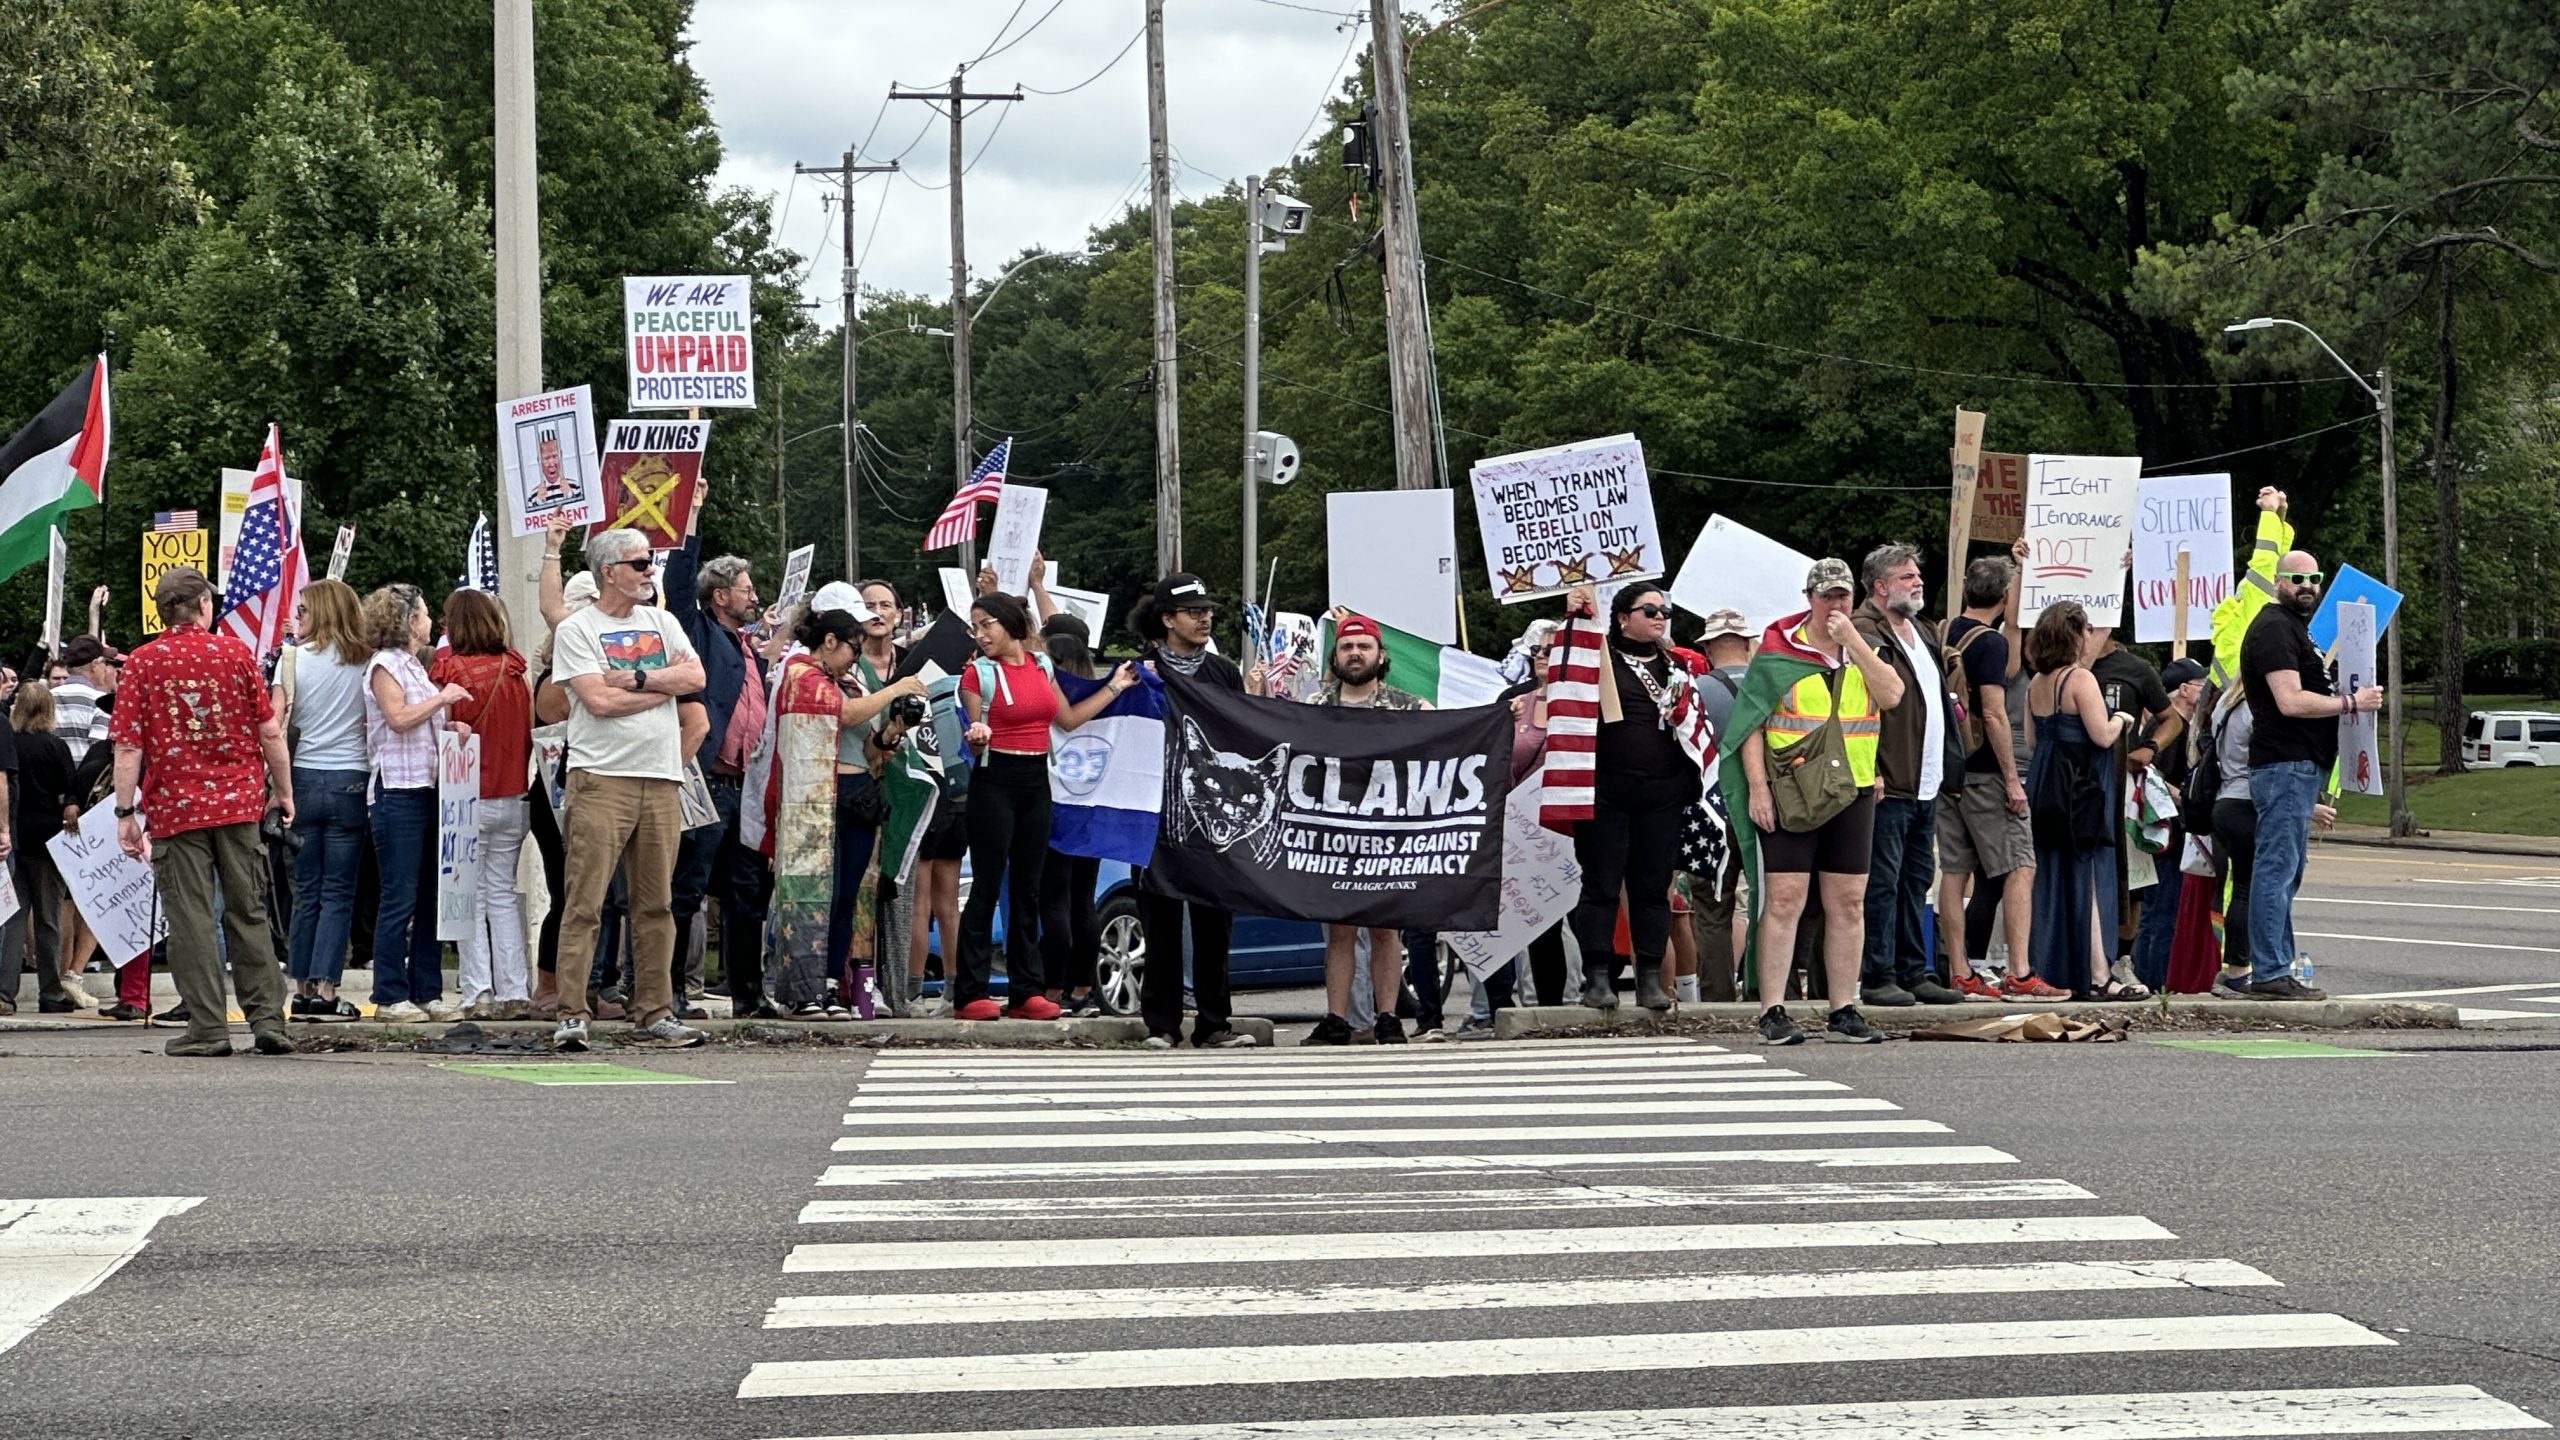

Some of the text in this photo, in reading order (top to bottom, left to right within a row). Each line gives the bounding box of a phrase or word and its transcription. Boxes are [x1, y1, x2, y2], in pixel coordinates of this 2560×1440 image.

[646, 283, 732, 307] WE ARE
[634, 311, 746, 333] PEACEFUL
[635, 335, 747, 374] UNPAID
[637, 376, 747, 400] PROTESTERS
[511, 393, 577, 417] ARREST THE
[614, 425, 701, 450] NO KINGS
[1491, 464, 1628, 504] WHEN TYRANNY
[2034, 459, 2112, 496] FIGHT
[1504, 485, 1628, 523] BECOMES LAW
[1983, 494, 2022, 517] THE
[2141, 497, 2228, 535] SILENCE
[1516, 509, 1614, 542] REBELLION
[146, 533, 202, 559] YOU
[1502, 525, 1638, 565] BECOMES DUTY
[1287, 754, 1487, 817] C.L.A.W.S.
[62, 834, 105, 860] We
[1282, 828, 1481, 855] CAT LOVERS AGAINST
[80, 852, 130, 891] Suppo
[1287, 851, 1470, 876] WHITE SUPREMACY
[1332, 881, 1417, 891] CAT MAGIC PUNKS
[1451, 931, 1493, 973] THER
